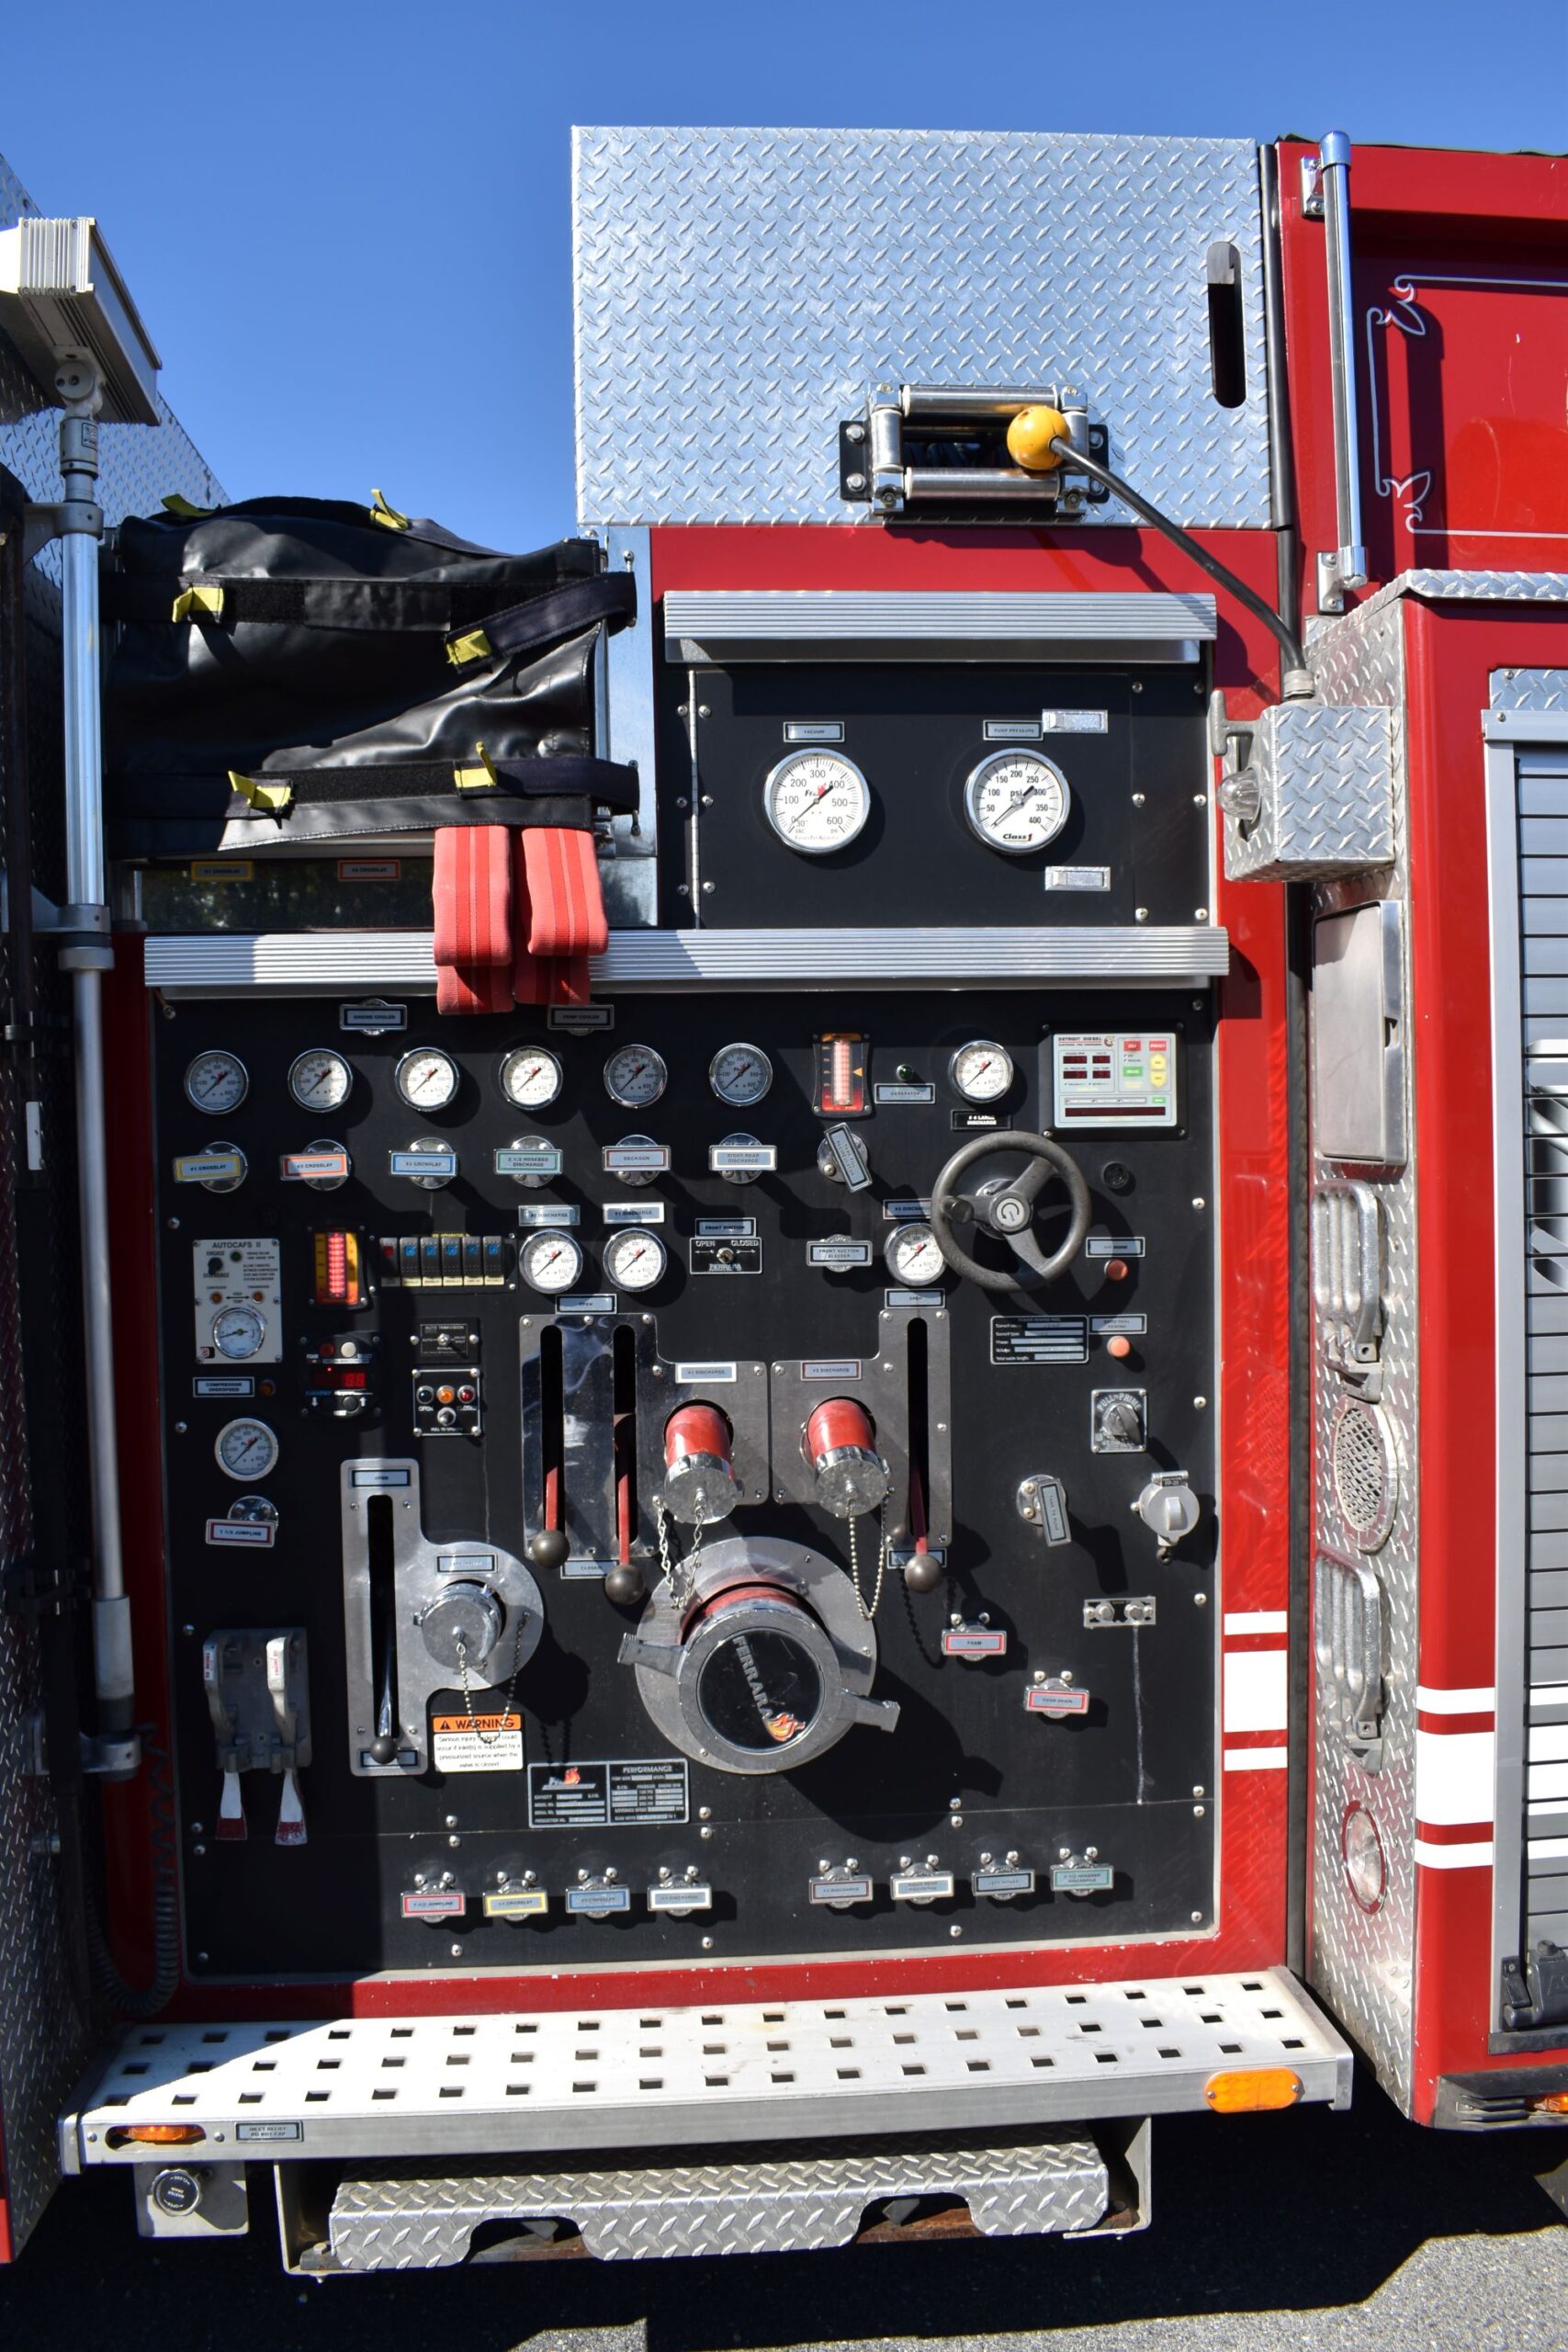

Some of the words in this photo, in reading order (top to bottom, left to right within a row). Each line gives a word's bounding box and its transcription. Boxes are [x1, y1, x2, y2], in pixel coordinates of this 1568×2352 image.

[1097, 1395, 1115, 1411] PULL
[1119, 1393, 1141, 1410] PRIME
[733, 1636, 773, 1719] FERRARA
[455, 1718, 514, 1729] WARNING
